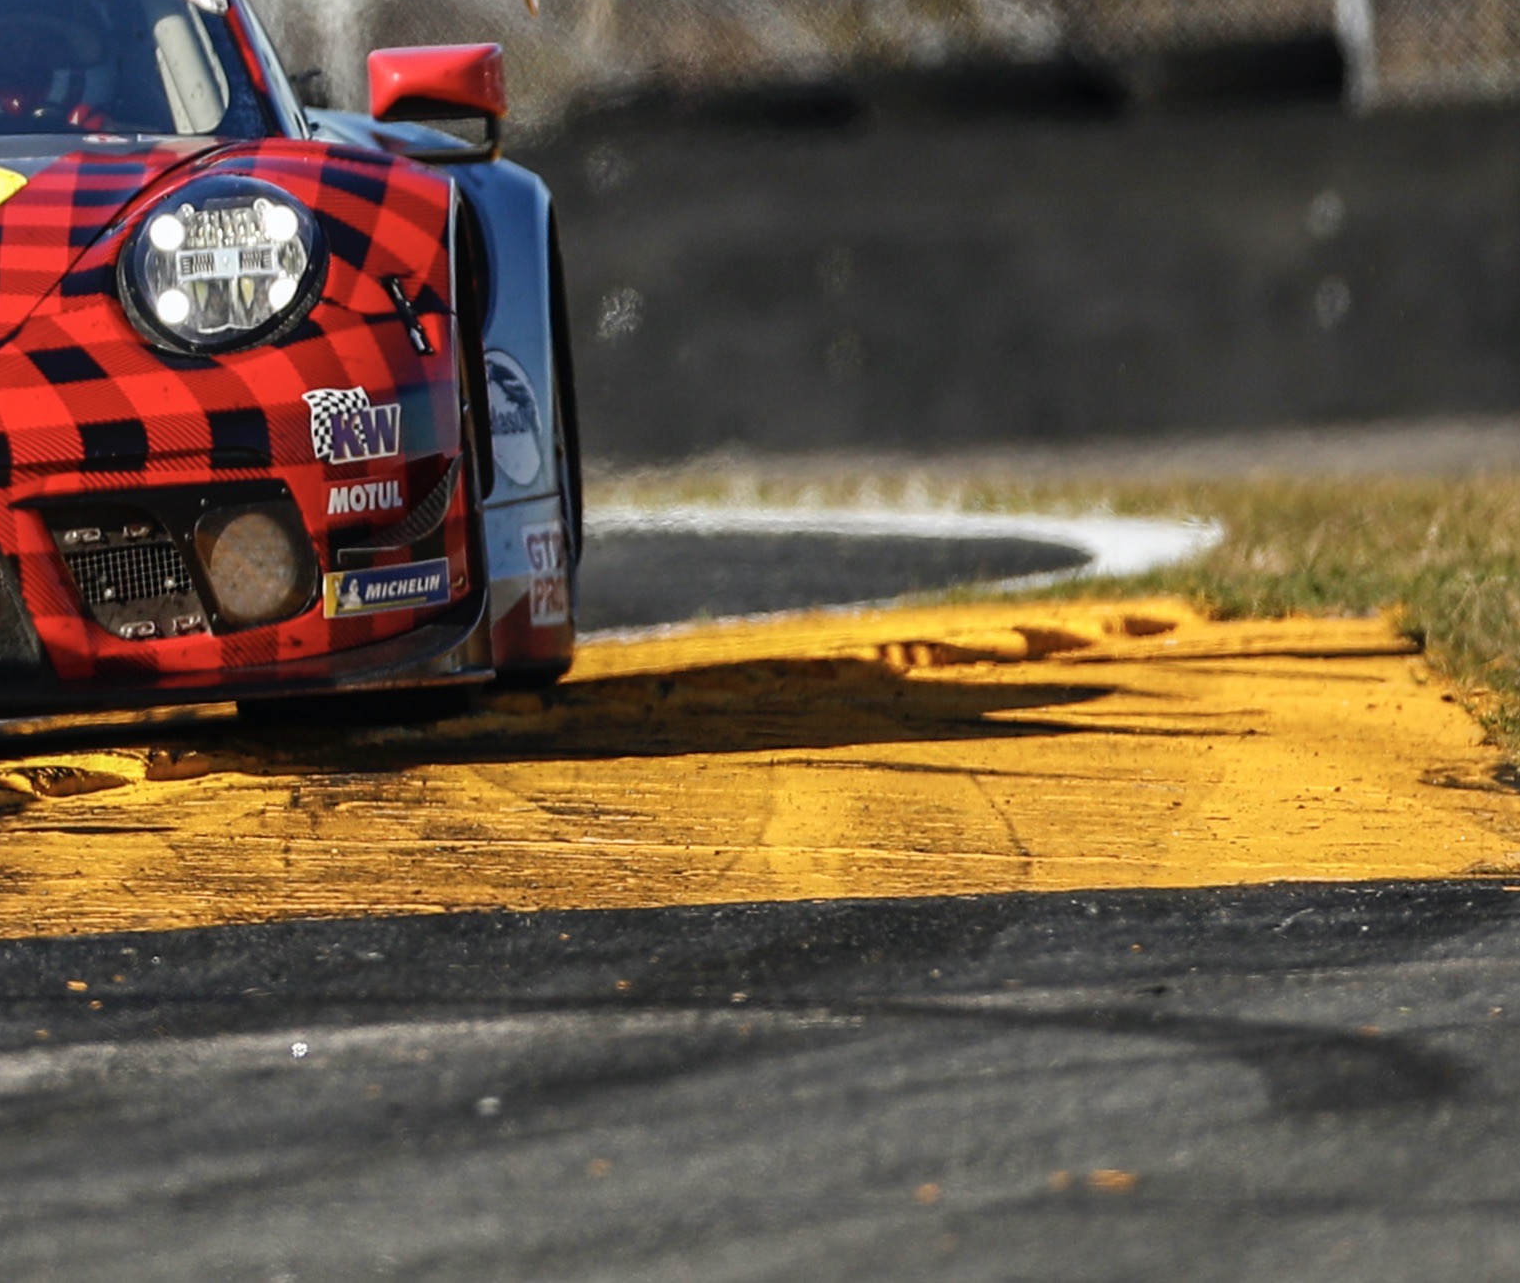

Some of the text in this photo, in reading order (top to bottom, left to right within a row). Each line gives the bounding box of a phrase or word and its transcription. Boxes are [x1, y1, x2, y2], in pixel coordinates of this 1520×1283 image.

[330, 404, 400, 462] KW
[327, 481, 403, 516] MOTUL
[365, 573, 441, 600] MICHELIN
